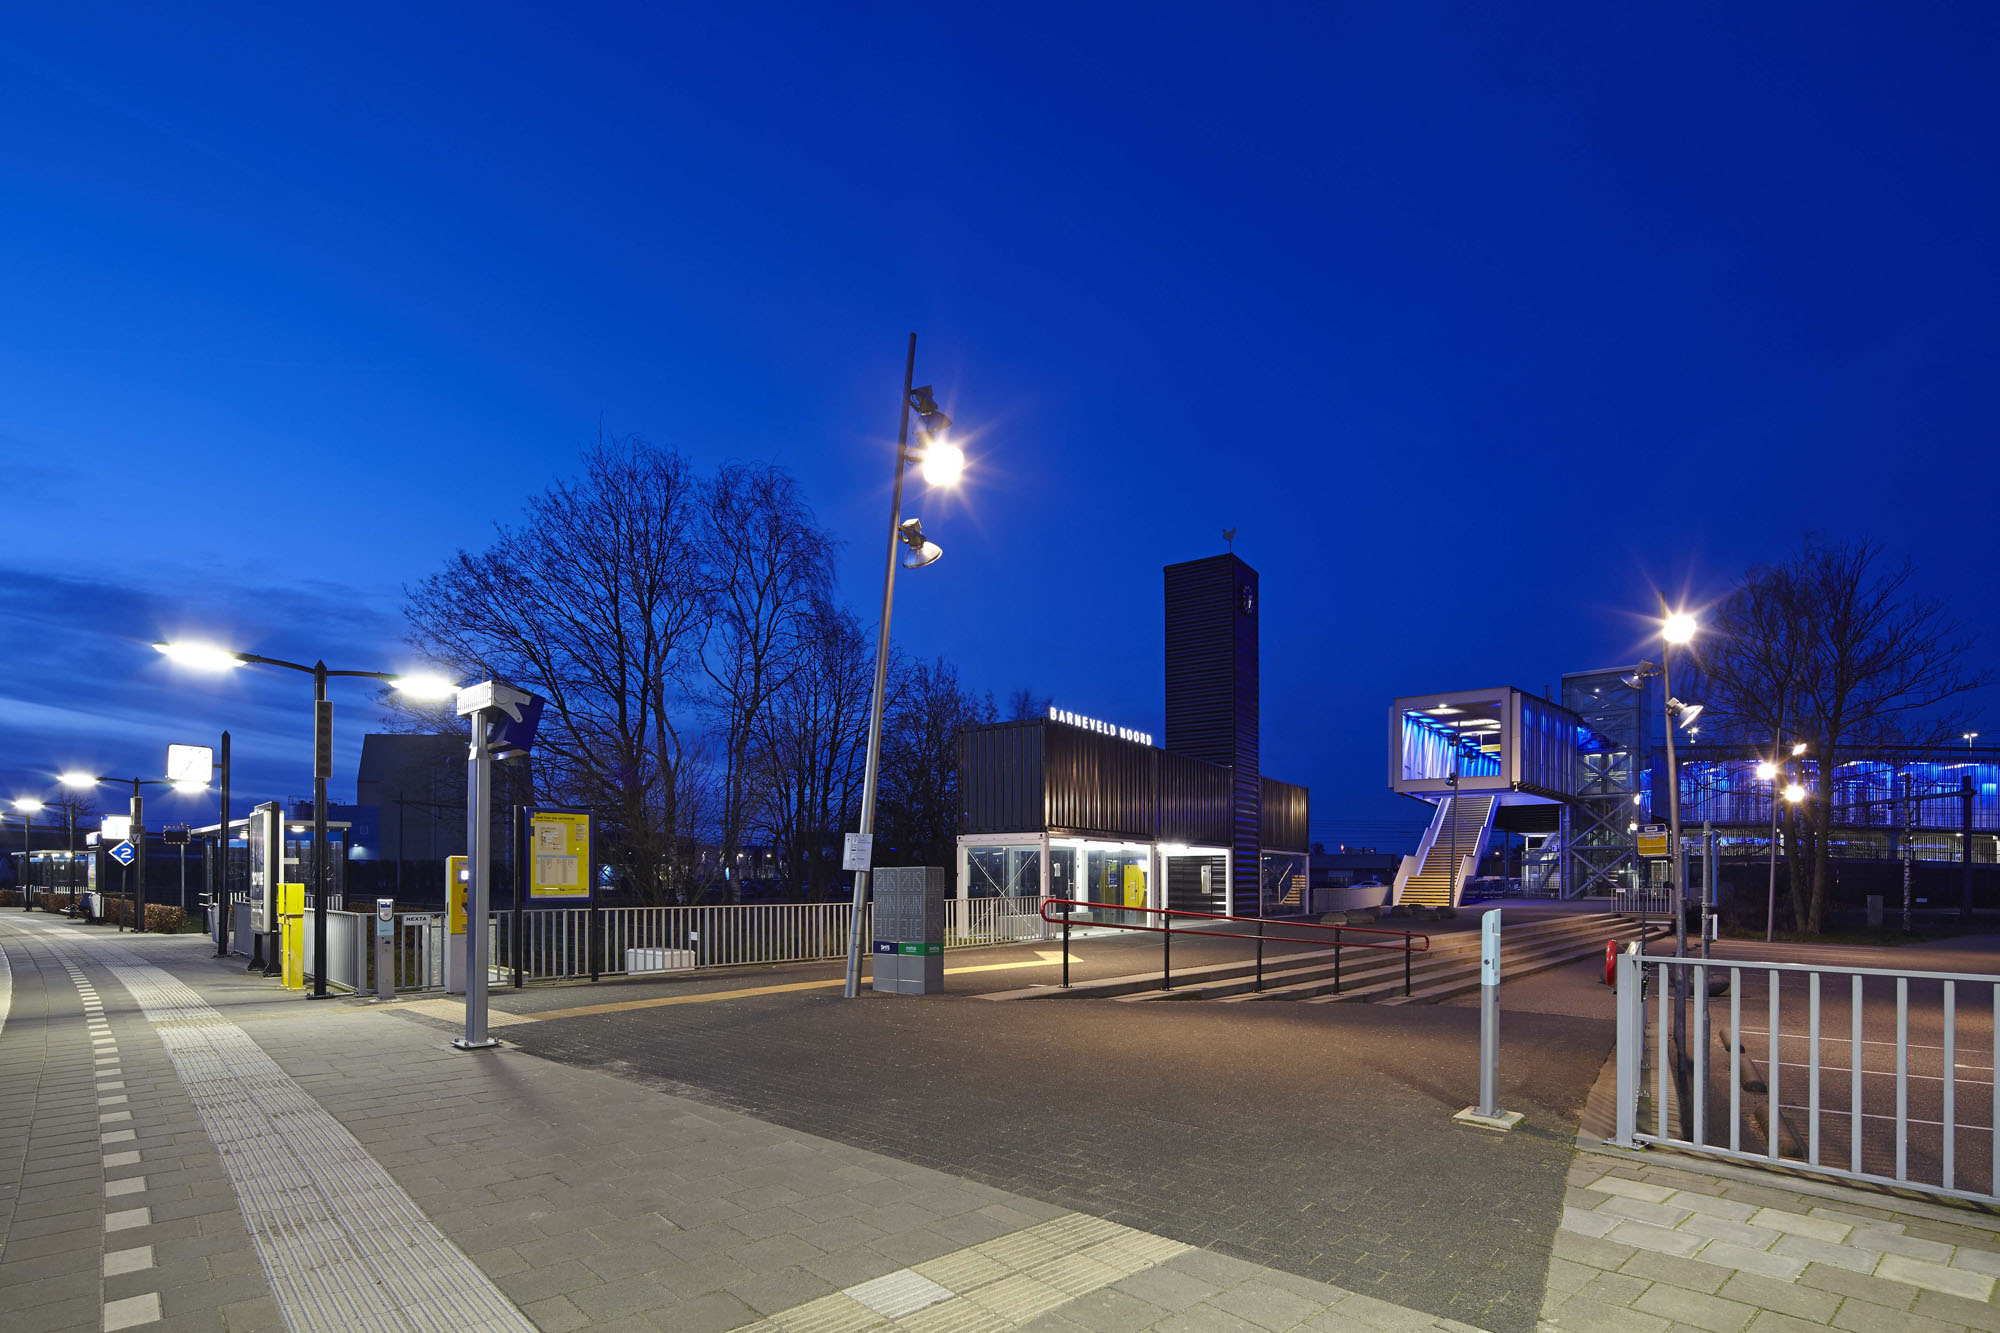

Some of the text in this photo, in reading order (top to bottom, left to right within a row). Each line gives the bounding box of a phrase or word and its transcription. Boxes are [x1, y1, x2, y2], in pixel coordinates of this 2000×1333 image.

[1049, 706, 1152, 746] BARNEVELD NOORD
[121, 848, 132, 858] 2
